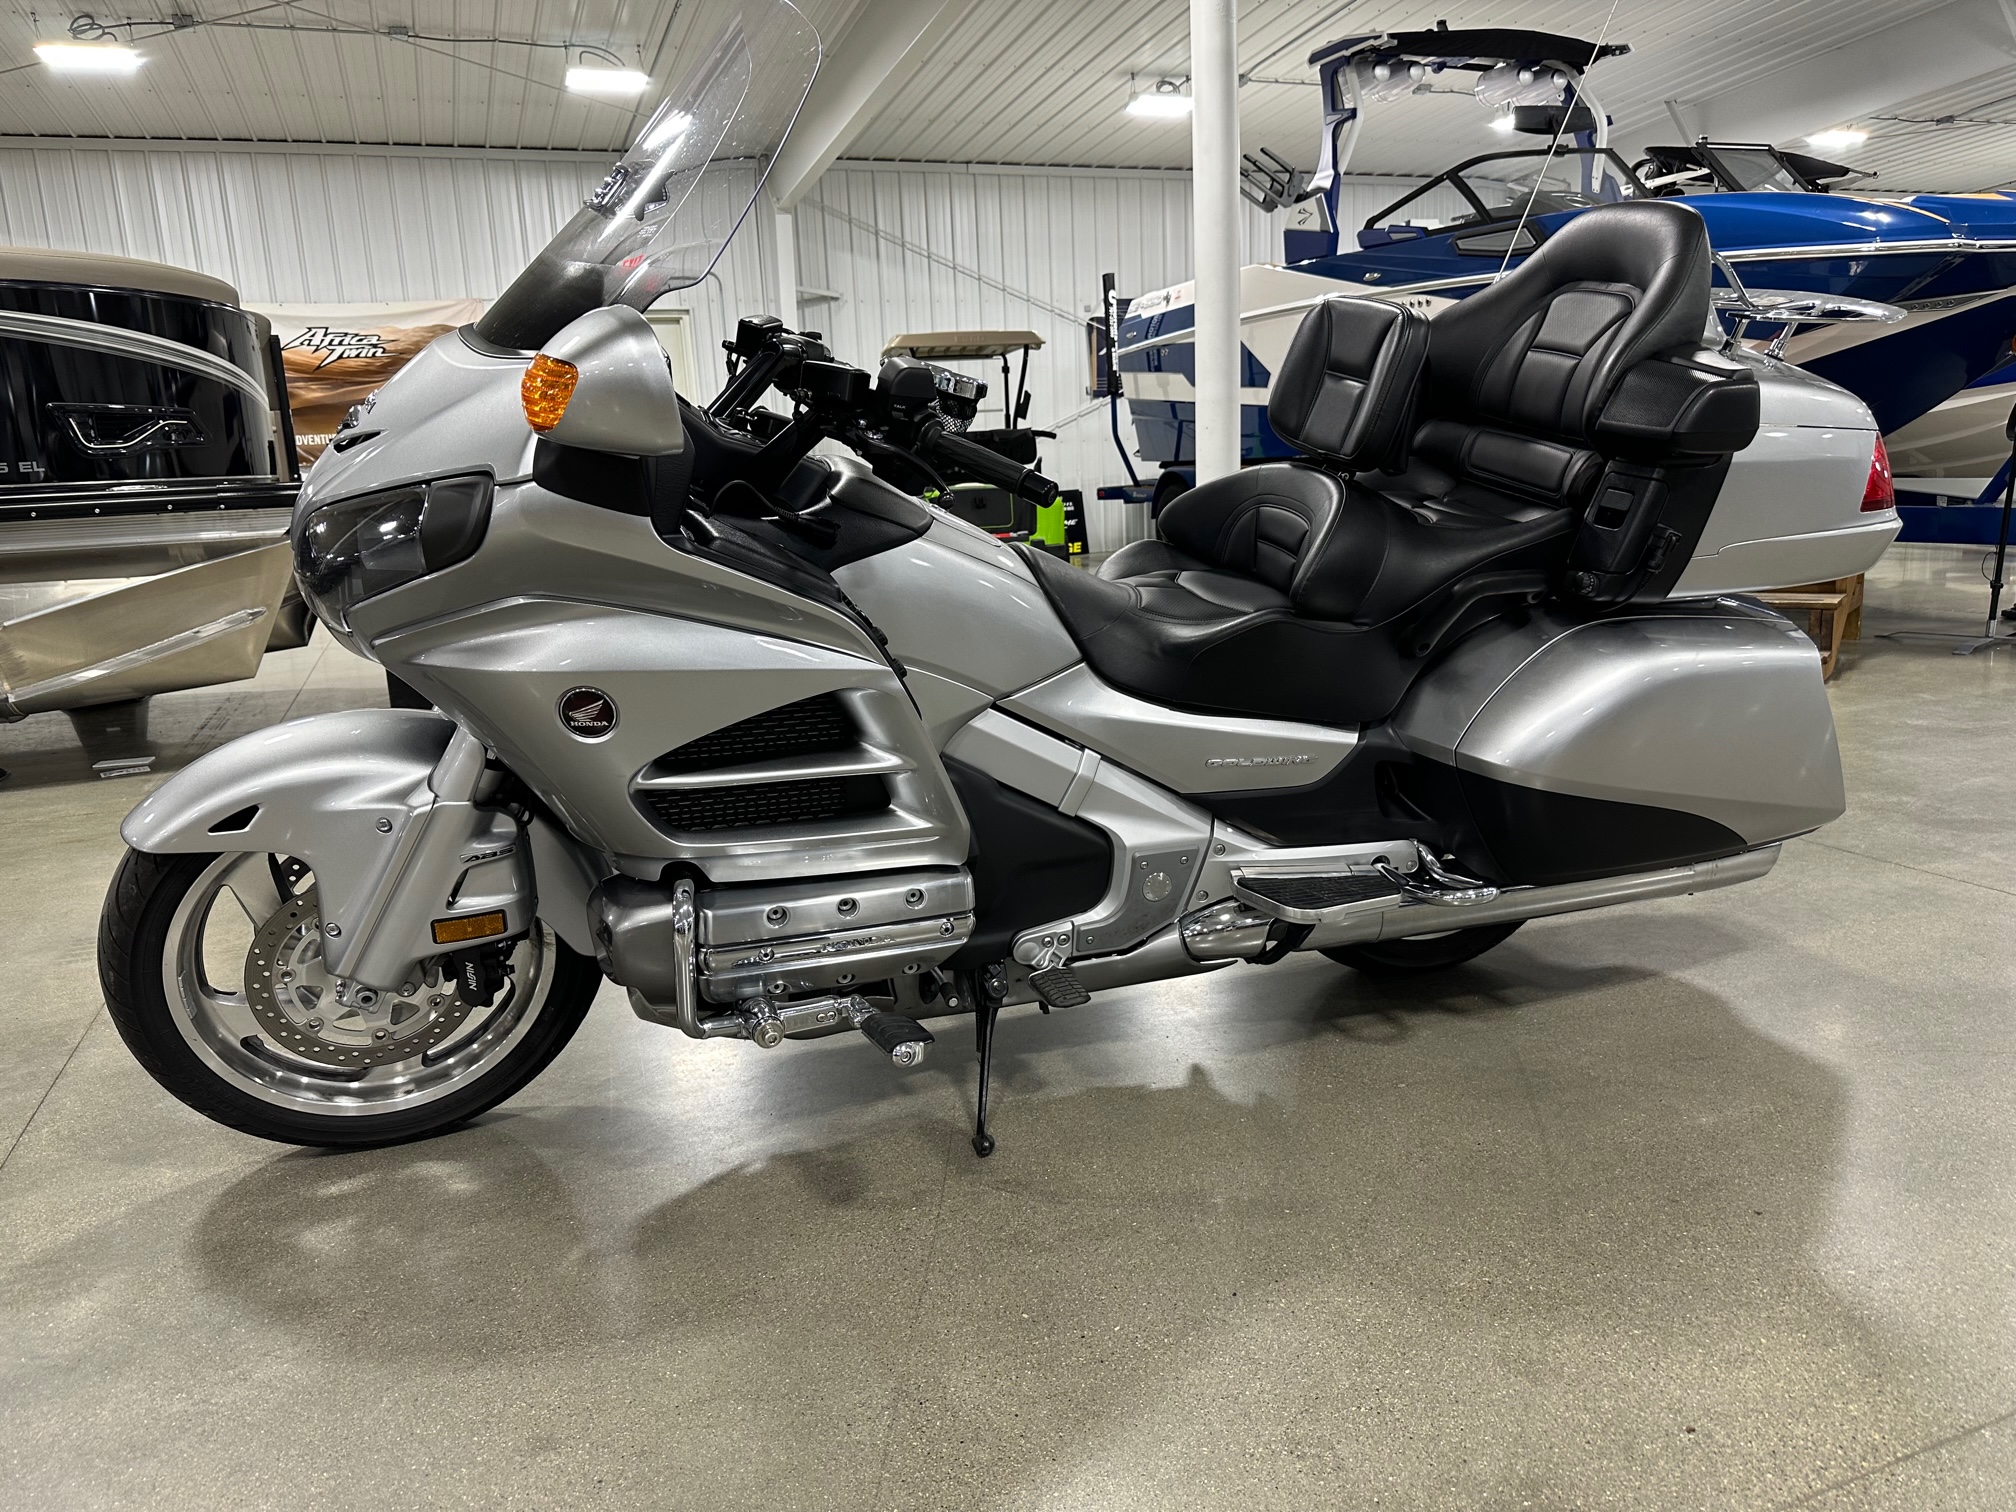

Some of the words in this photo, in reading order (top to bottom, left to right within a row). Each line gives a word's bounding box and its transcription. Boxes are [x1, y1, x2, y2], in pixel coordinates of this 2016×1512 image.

[281, 327, 400, 353] Africa
[313, 345, 404, 372] Twin
[296, 433, 337, 446] DVENTU
[18, 461, 46, 473] EL
[463, 846, 515, 864] ABS
[820, 934, 897, 953] HONDA
[465, 961, 478, 991] NISSIN
